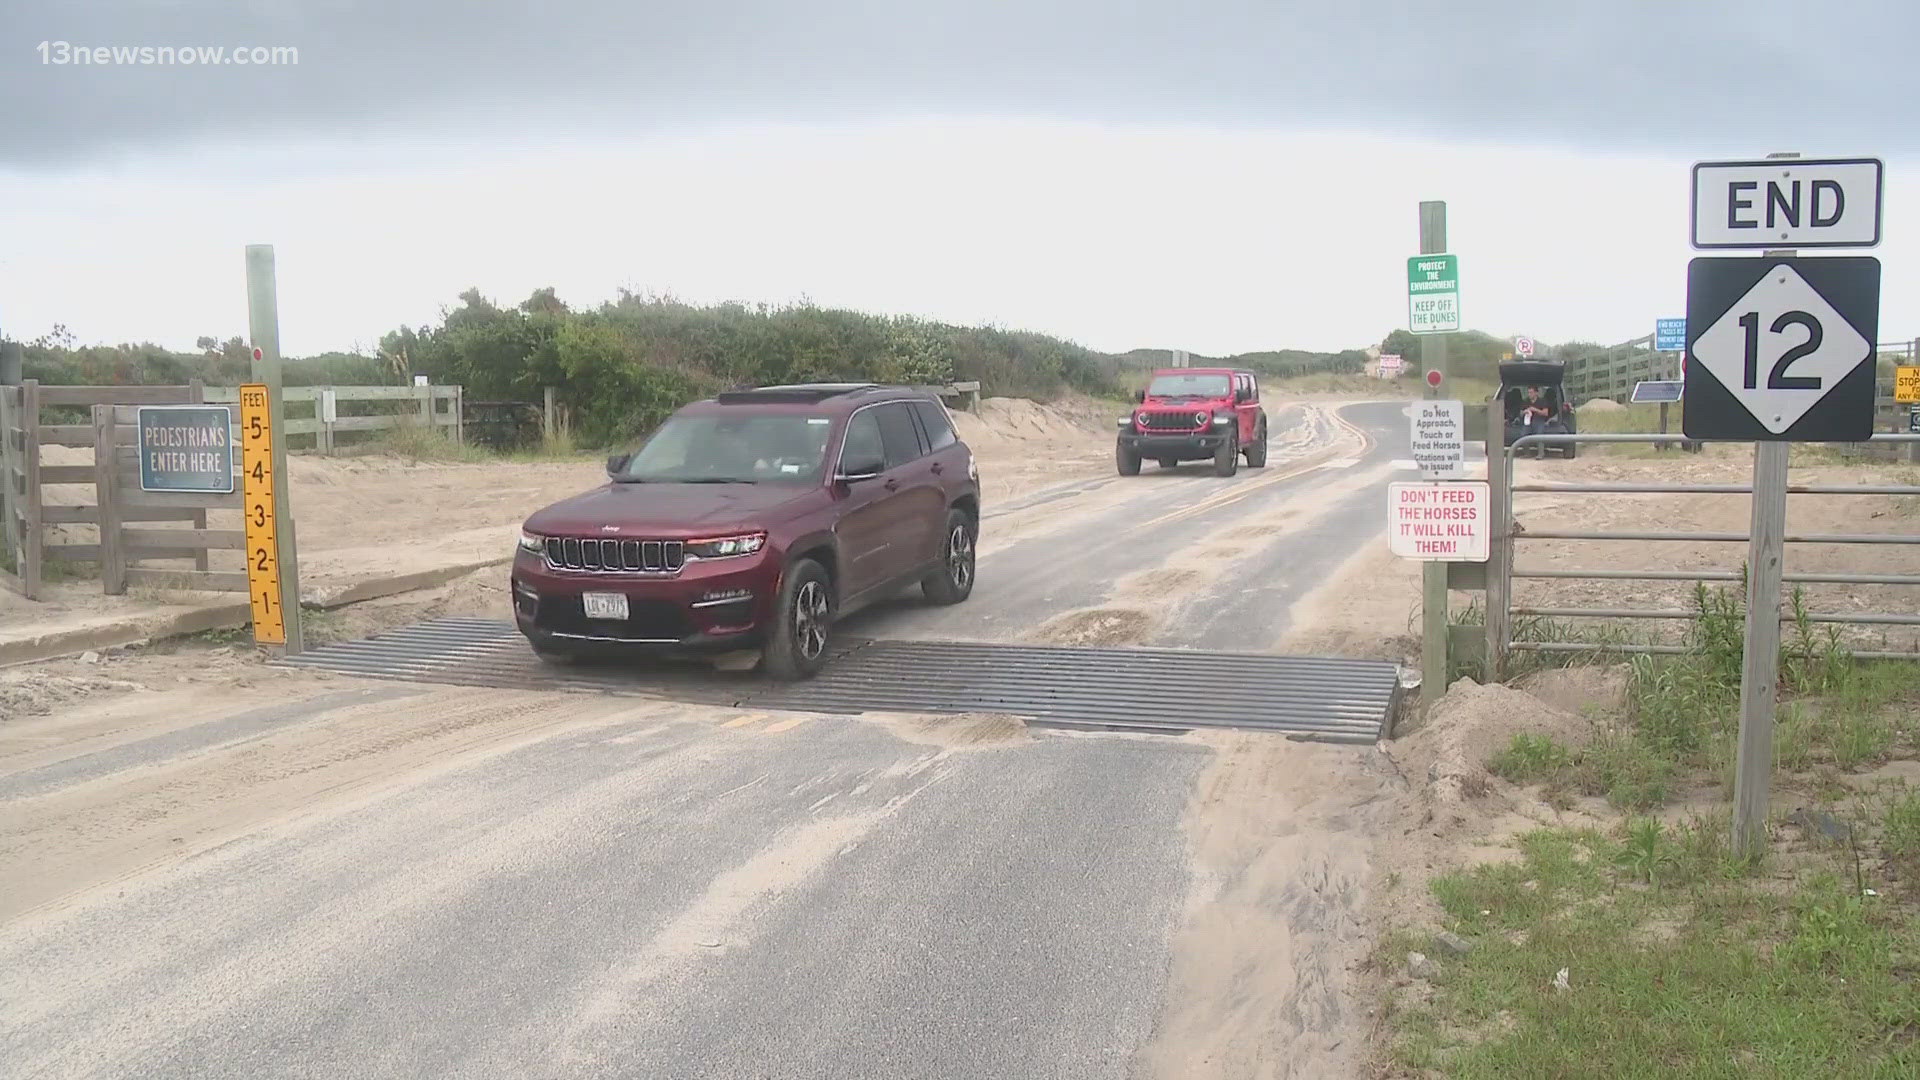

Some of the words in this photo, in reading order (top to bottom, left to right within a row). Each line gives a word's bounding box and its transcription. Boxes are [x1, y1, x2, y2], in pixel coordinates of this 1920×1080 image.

[1727, 179, 1845, 229] END
[1417, 261, 1447, 272] PROTECT
[1426, 271, 1440, 281] THE
[1410, 280, 1456, 291] ENVIRONMENT
[1415, 301, 1435, 312] KEEP
[1437, 300, 1453, 311] OFF
[1413, 314, 1428, 324] THE
[1429, 312, 1456, 324] DUNES
[1738, 310, 1824, 390] 12
[243, 393, 265, 407] FEET
[1422, 410, 1433, 418] Do
[1435, 409, 1450, 418] Not
[251, 416, 262, 440] 5
[1416, 419, 1457, 429] Approach,
[145, 427, 225, 447] PEDESTRIANS
[1419, 431, 1443, 439] Touch
[1412, 441, 1431, 450] Feed
[1433, 441, 1461, 450] Horses
[150, 452, 187, 472] ENTER
[190, 452, 222, 473] HERE
[1414, 453, 1445, 462] Citations
[1447, 453, 1460, 461] will
[252, 460, 264, 484] 4
[1430, 462, 1453, 471] issued
[1401, 490, 1439, 503] DON'T
[1442, 490, 1475, 503] FEED
[254, 504, 265, 528] 3
[1398, 507, 1422, 519] THE
[1424, 507, 1477, 520] HORSES
[1400, 524, 1411, 536] IT
[1413, 524, 1444, 536] WILL
[1447, 524, 1475, 536] KILL
[1415, 541, 1457, 553] THEM!
[256, 548, 268, 571] 2
[262, 591, 269, 614] 1
